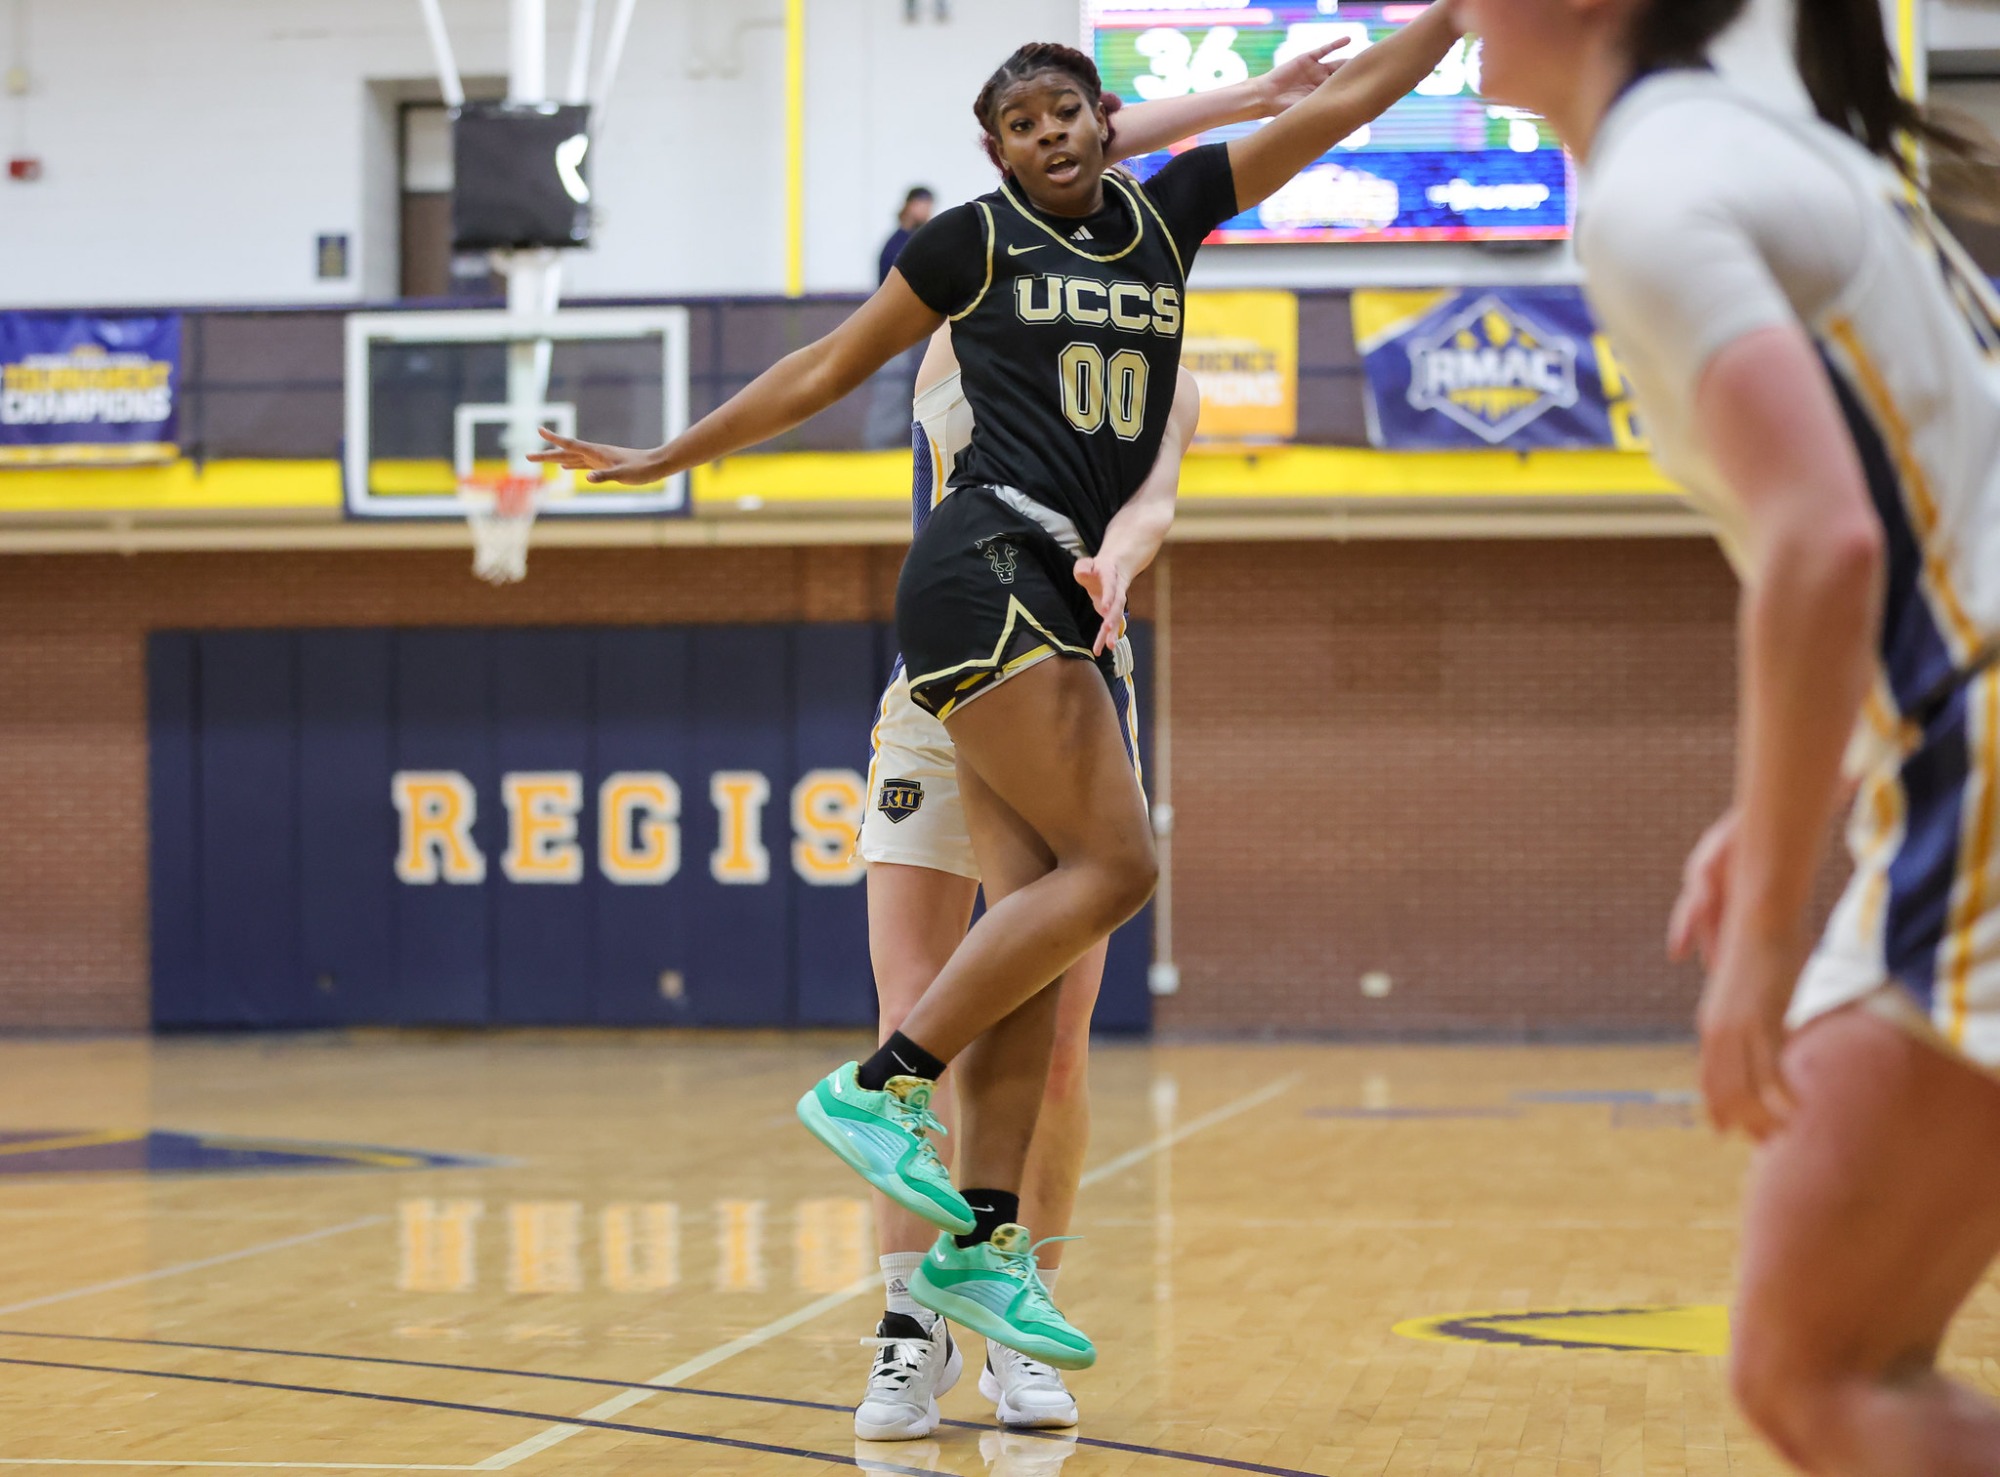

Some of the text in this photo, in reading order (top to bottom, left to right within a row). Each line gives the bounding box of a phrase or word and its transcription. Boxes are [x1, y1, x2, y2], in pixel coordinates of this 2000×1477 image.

[1133, 26, 1248, 100] 36
[1013, 272, 1181, 338] UCCS
[1, 382, 172, 425] CHAMPIONS
[1058, 341, 1149, 442] 00
[1424, 349, 1565, 396] RMAC
[391, 768, 869, 886] REGIS
[878, 786, 924, 811] RU
